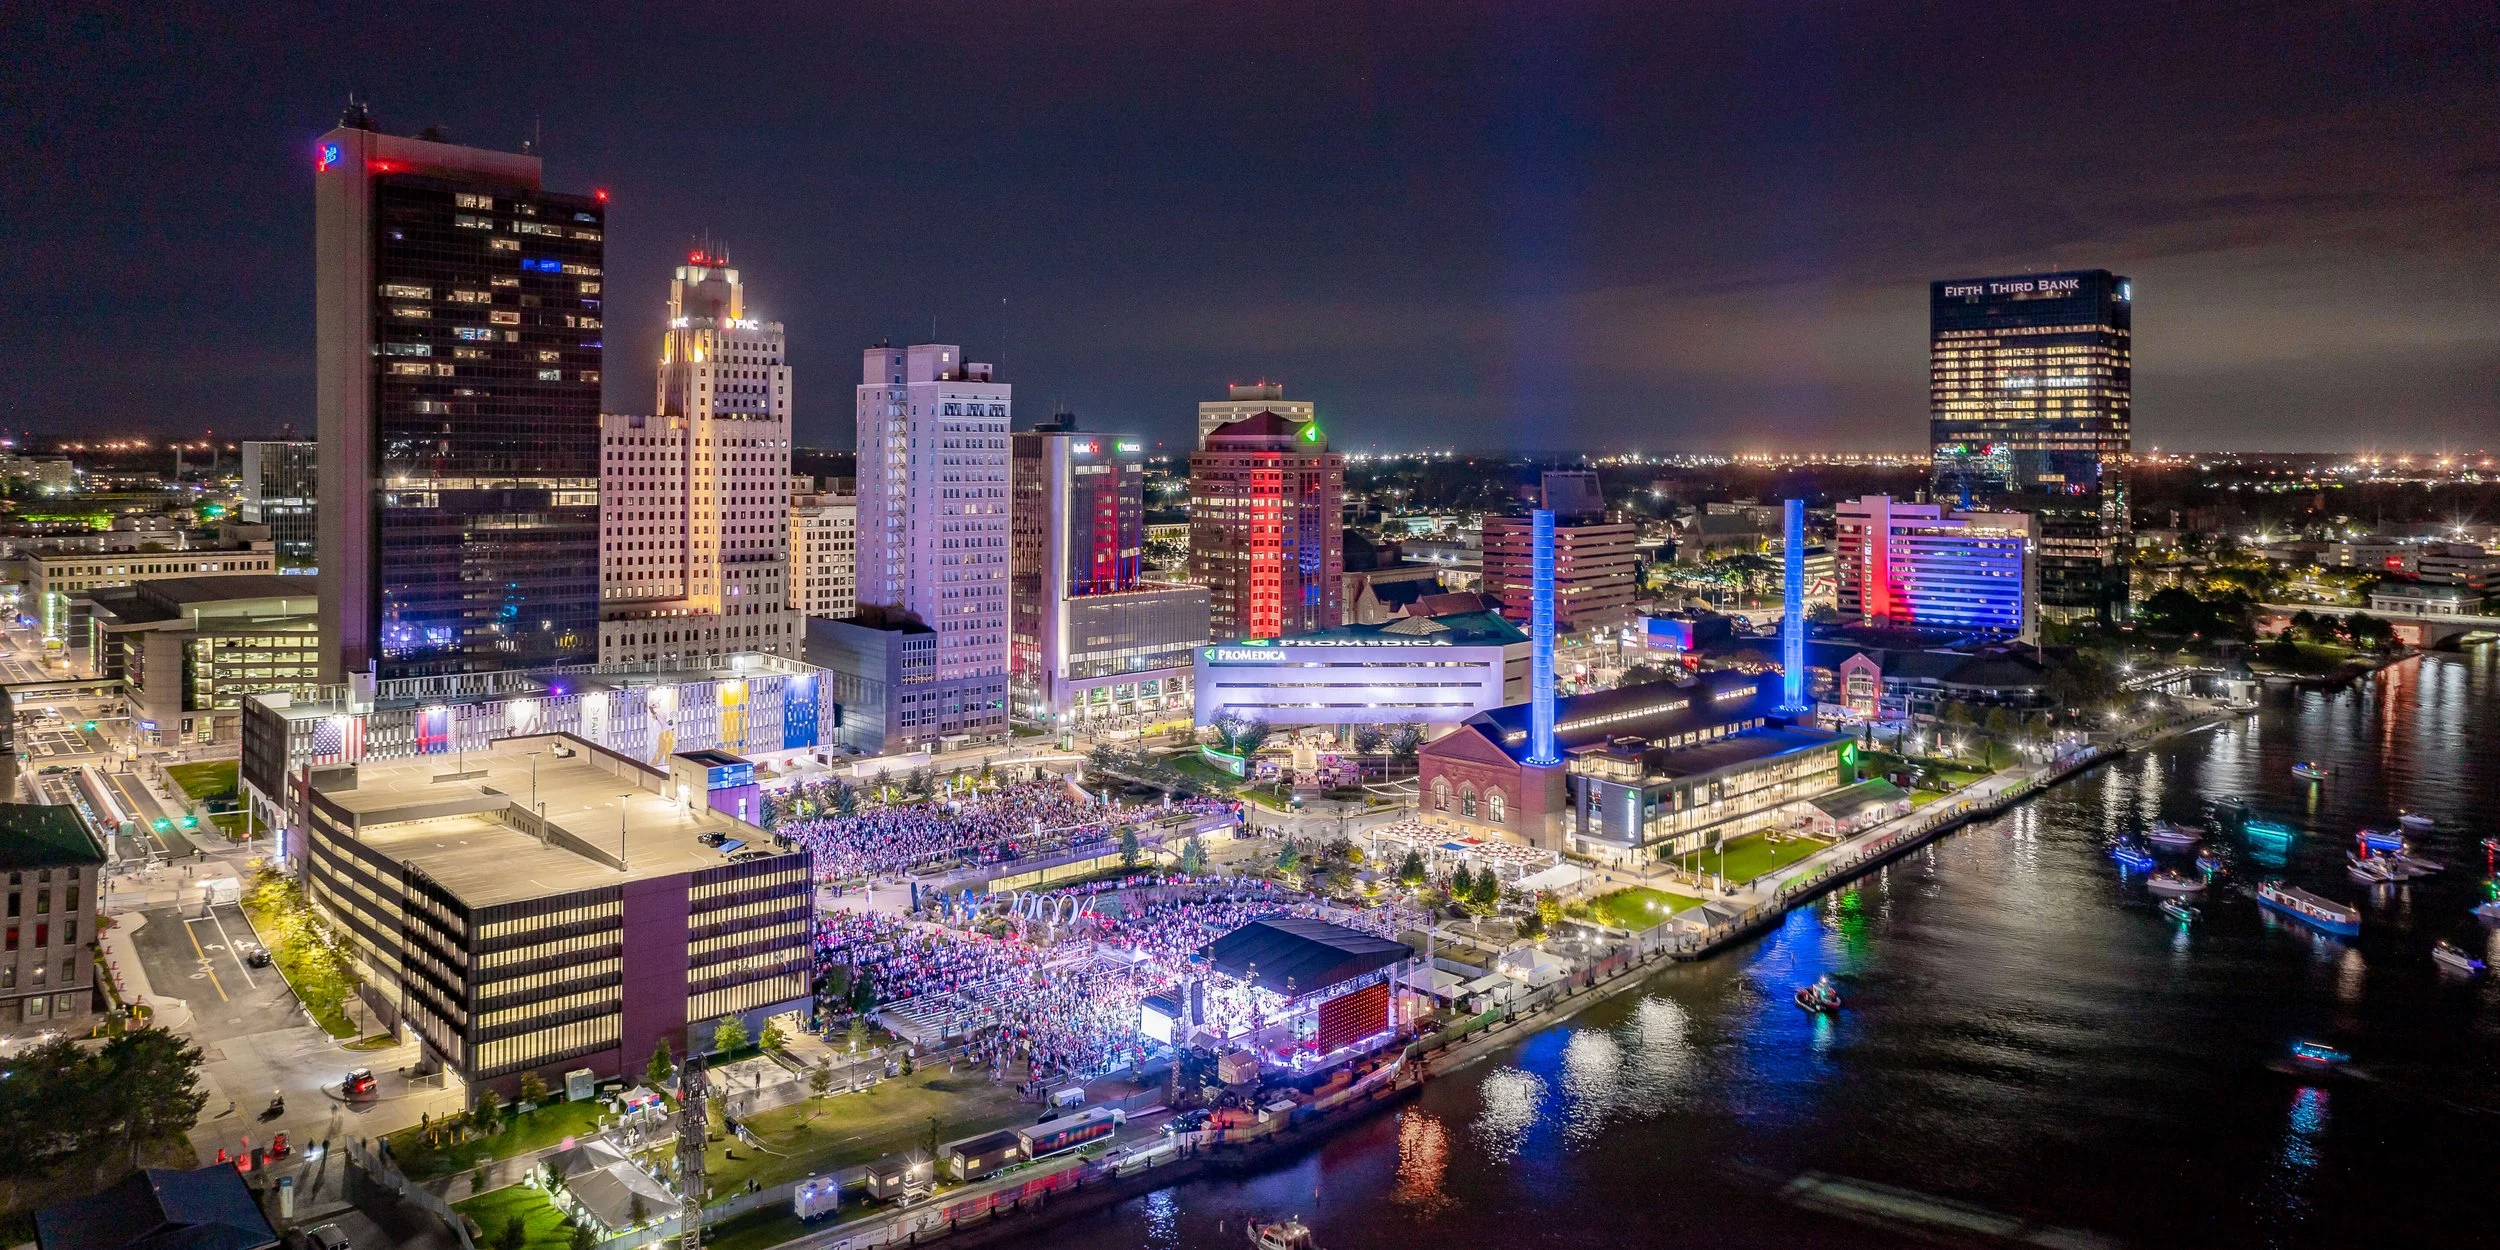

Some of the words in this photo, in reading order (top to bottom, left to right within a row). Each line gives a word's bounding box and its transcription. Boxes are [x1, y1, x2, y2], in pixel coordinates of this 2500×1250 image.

[1944, 285, 1983, 297] FIFTH
[1990, 282, 2034, 294] THIRD
[2038, 279, 2080, 291] BANK
[735, 319, 759, 330] PNC
